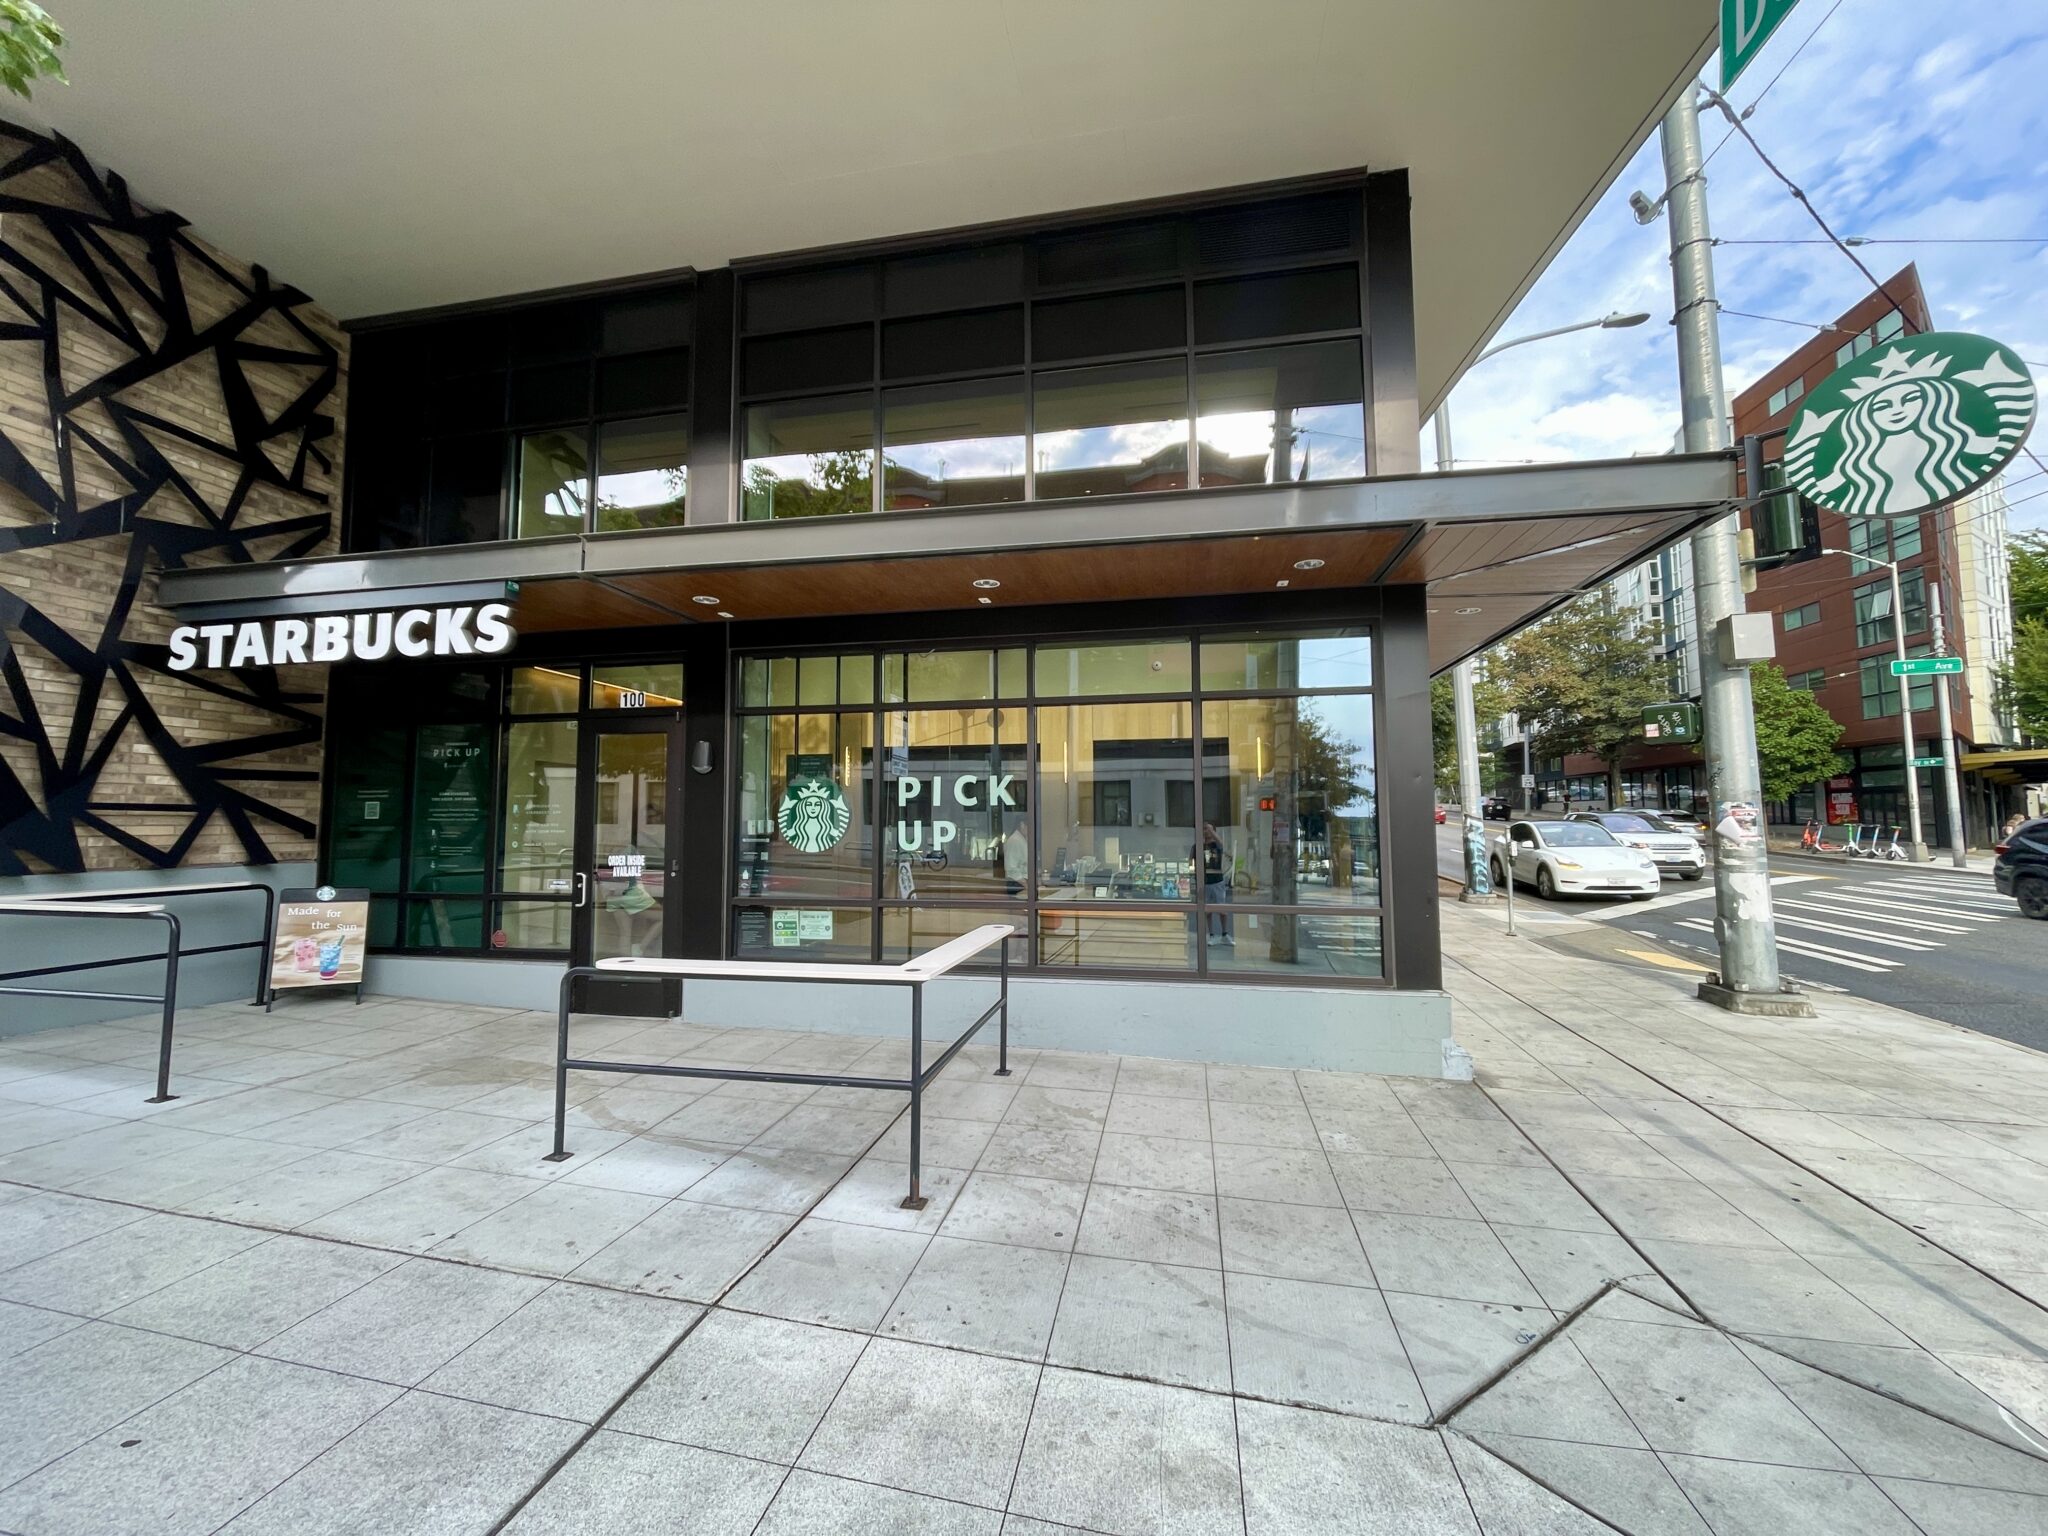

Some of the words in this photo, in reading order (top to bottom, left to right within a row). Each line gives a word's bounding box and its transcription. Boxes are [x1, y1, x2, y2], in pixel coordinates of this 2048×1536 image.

[167, 603, 513, 672] STARBUCKS
[1902, 663, 1916, 672] 1st
[622, 692, 645, 707] 100
[432, 748, 460, 757] PICK
[465, 747, 481, 757] UP
[898, 774, 1017, 807] PICK
[898, 820, 957, 852] UP
[607, 855, 626, 867] ORDER
[626, 855, 646, 866] INSIDE
[612, 866, 642, 877] AVAILABLE
[287, 906, 320, 916] Made
[326, 909, 342, 918] for
[311, 920, 330, 930] the
[336, 923, 357, 931] Sun
